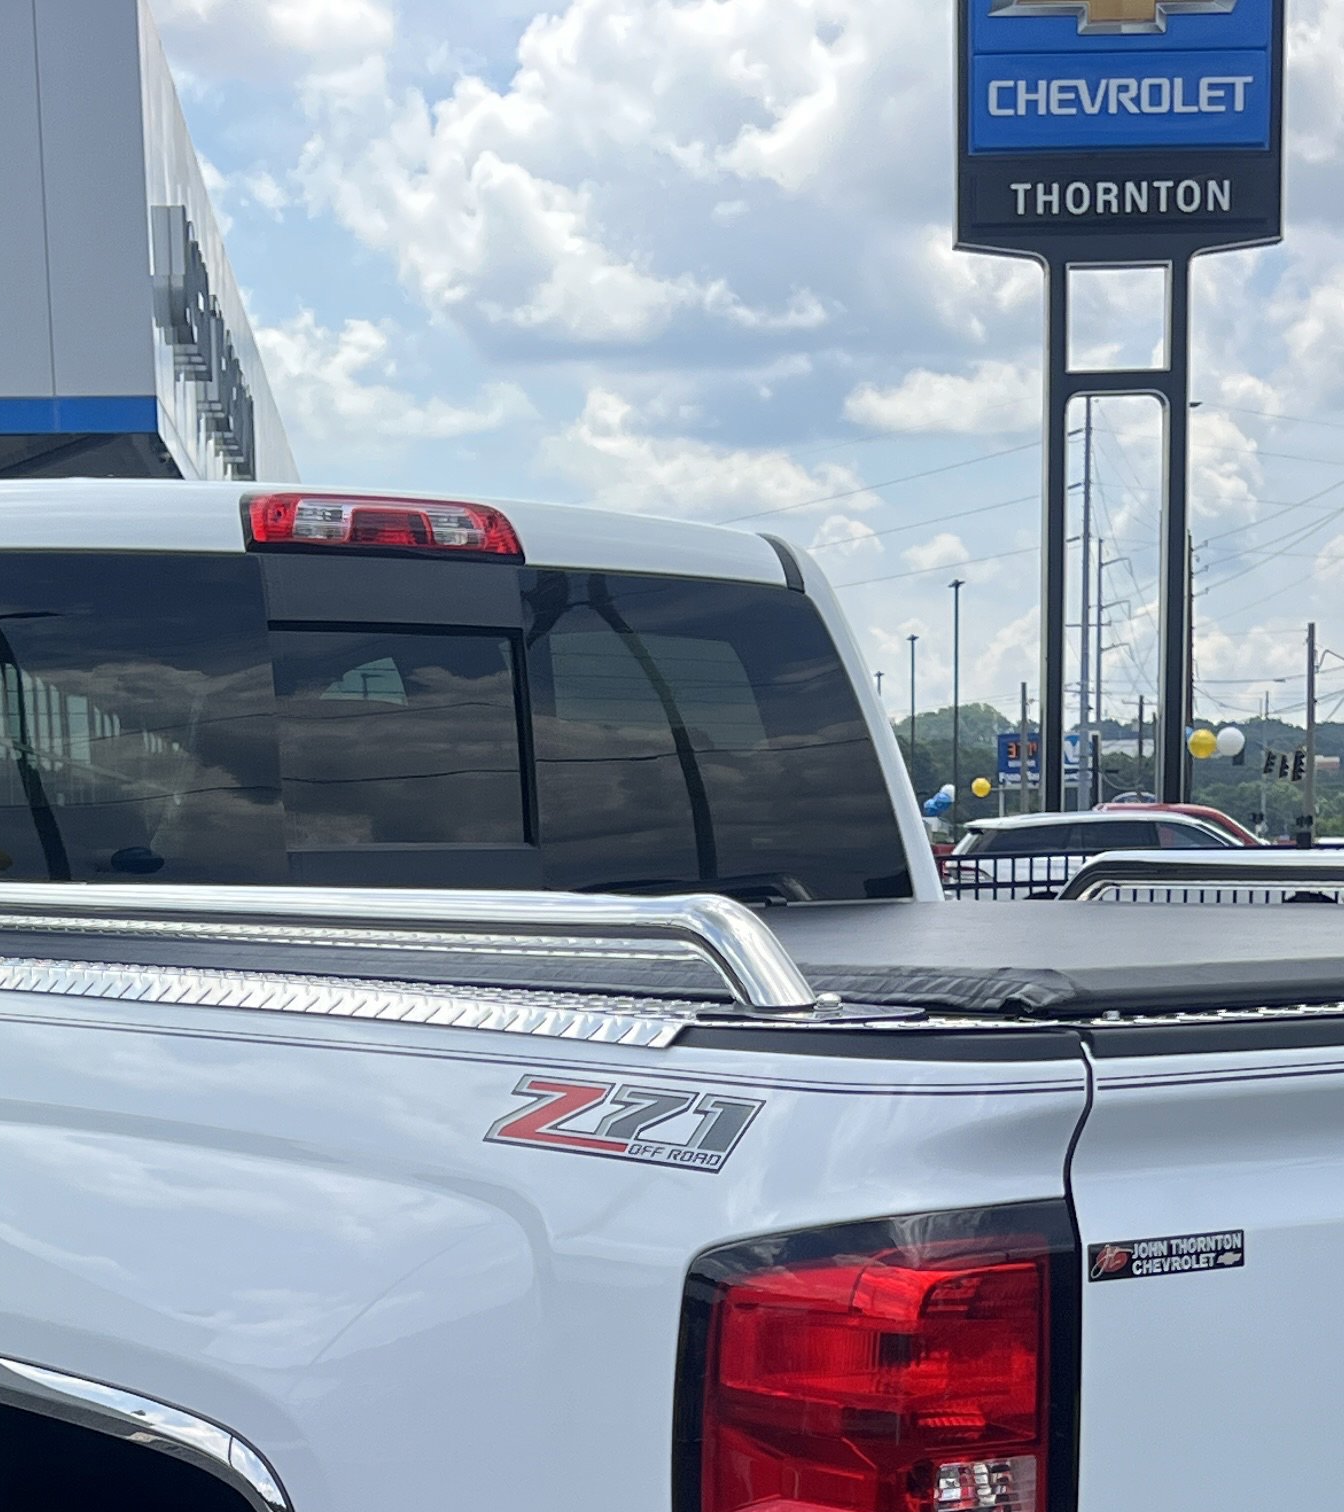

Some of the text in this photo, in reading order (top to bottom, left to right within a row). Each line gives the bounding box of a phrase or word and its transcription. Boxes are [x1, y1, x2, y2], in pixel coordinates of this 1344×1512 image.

[988, 76, 1253, 116] CHEVROLET
[1010, 180, 1232, 215] THORNTON
[483, 1074, 766, 1166] Z71
[628, 1143, 722, 1166] OFF ROAD
[1131, 1232, 1242, 1259] JOHN THORNTON
[1131, 1252, 1216, 1276] CHEVROLET
